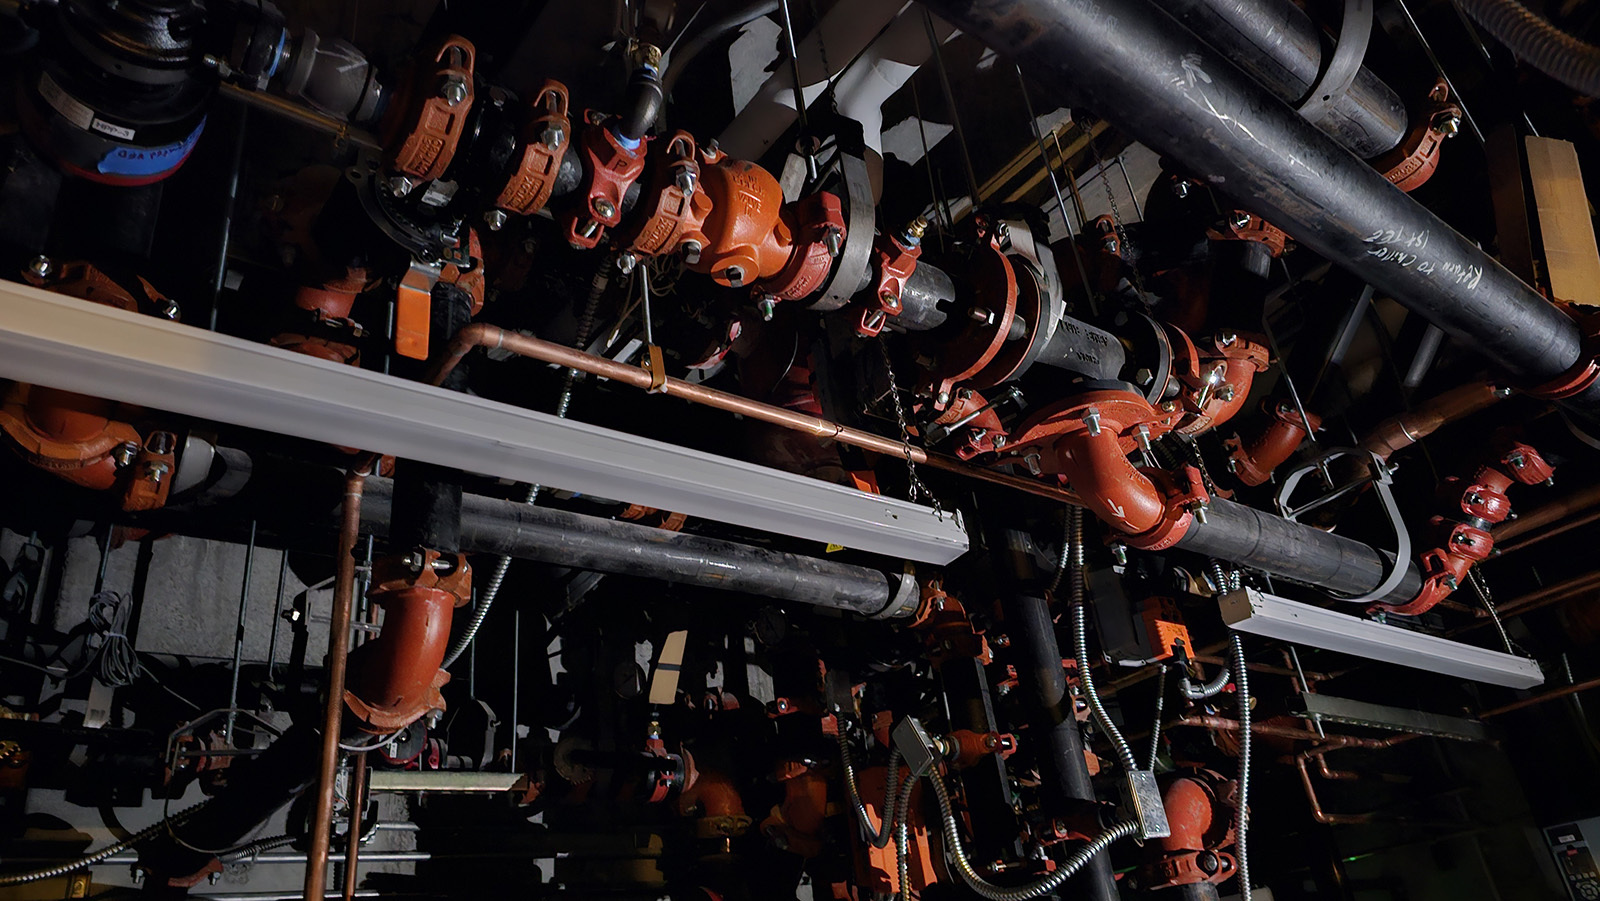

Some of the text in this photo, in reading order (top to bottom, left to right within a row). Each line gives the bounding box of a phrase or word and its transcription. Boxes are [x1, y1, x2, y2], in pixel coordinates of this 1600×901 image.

[1367, 247, 1483, 290] Return to Chiller
